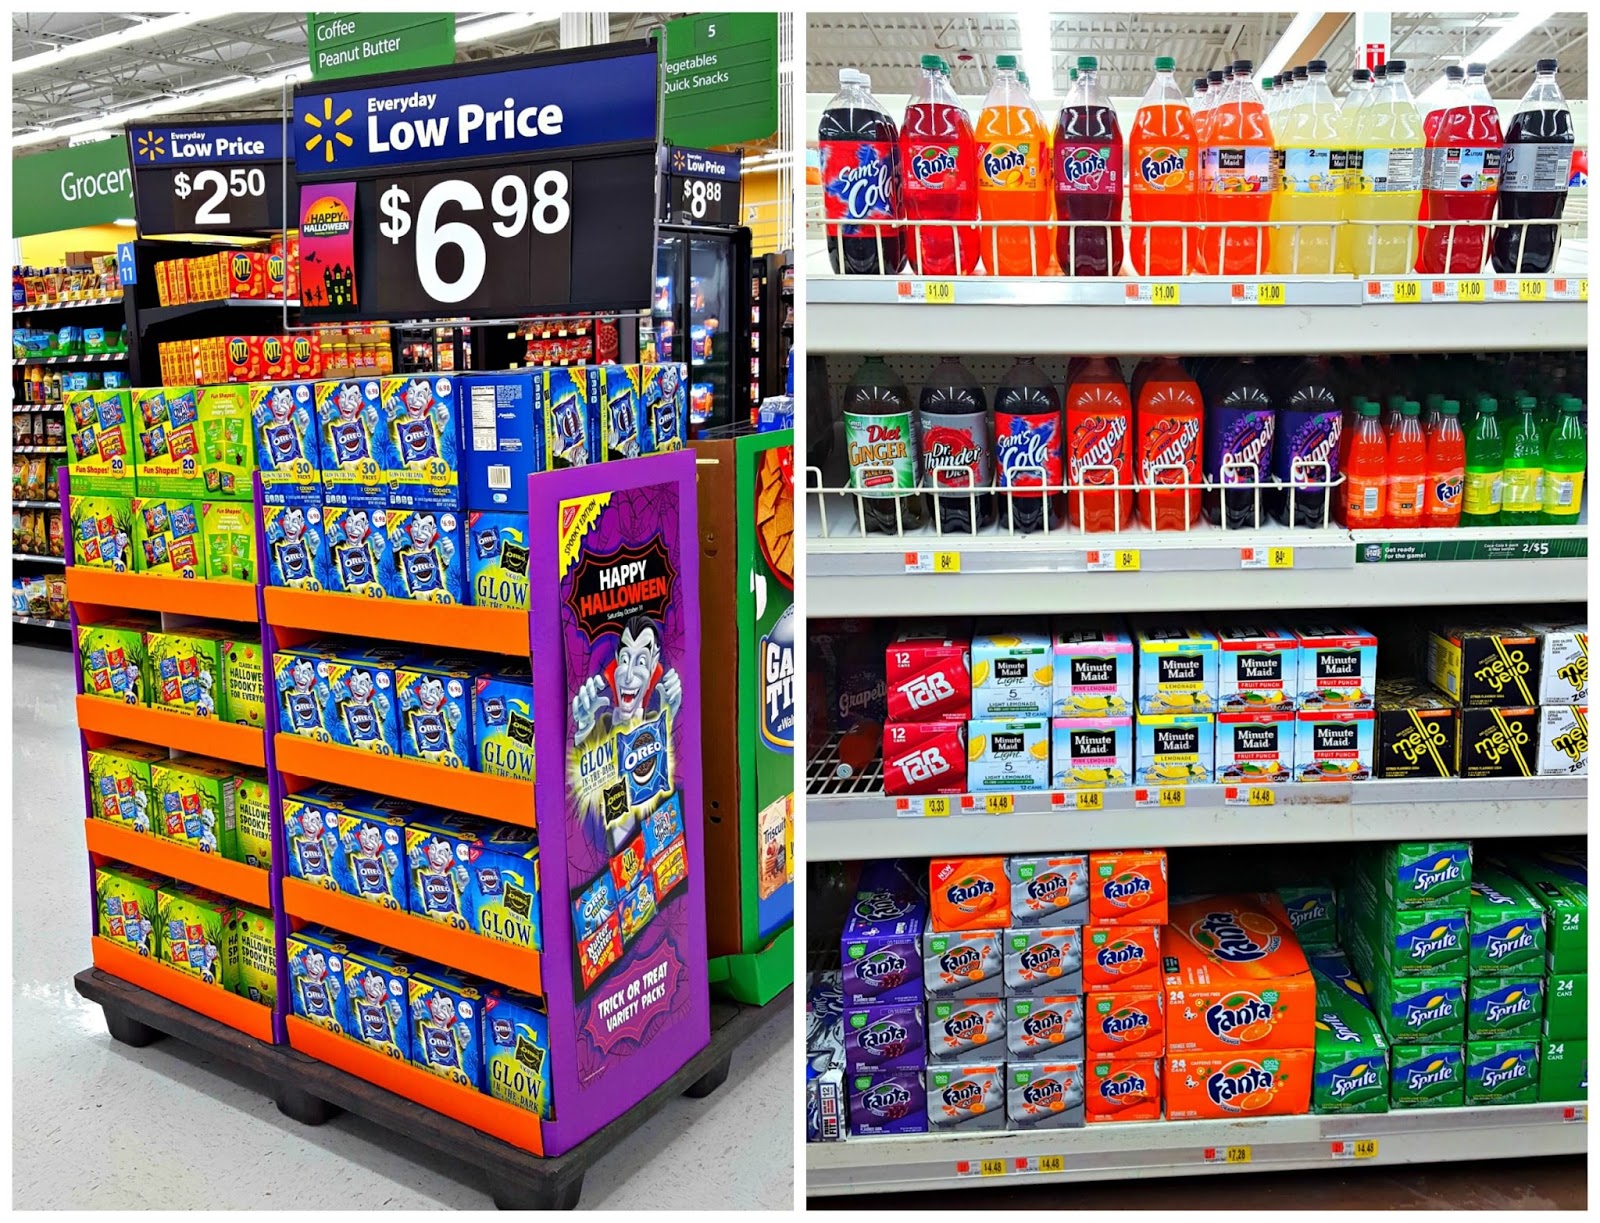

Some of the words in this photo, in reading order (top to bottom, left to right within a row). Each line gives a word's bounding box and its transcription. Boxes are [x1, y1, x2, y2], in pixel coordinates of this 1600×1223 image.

[317, 21, 355, 41] Coffee
[708, 25, 716, 37] 5
[319, 45, 359, 68] Peanut
[363, 37, 400, 58] Butter
[693, 71, 728, 87] Snacks
[368, 93, 437, 113] Everyday
[368, 115, 449, 153] Low
[459, 98, 563, 144] Price
[171, 131, 205, 141] Everyday
[171, 140, 211, 158] Low
[216, 138, 265, 156] Price
[687, 159, 704, 171] Low
[706, 161, 725, 175] Price
[913, 155, 954, 181] Fanta
[1065, 156, 1105, 180] Fanta
[1142, 156, 1183, 181] Fanta
[61, 167, 132, 202] Grocery
[839, 160, 879, 193] Sam's
[850, 168, 894, 218] Cola
[311, 212, 343, 224] HAPPY
[304, 221, 349, 233] HALLOWEEN
[121, 245, 132, 262] A
[121, 267, 133, 282] 11
[232, 259, 250, 278] RITZ
[929, 284, 949, 298] $1.00
[1260, 285, 1280, 299] $1.00
[1397, 283, 1416, 296] $1.00
[1522, 282, 1541, 294] $1.00
[229, 343, 248, 359] RITZ
[294, 342, 312, 358] RITZ
[274, 434, 294, 446] OREO
[867, 425, 901, 443] Diet
[998, 430, 1030, 454] Sam's
[1084, 435, 1099, 449] ENJOY
[1310, 434, 1325, 448] ENJOY
[849, 441, 907, 466] GINGER
[933, 443, 951, 456] Dr.
[1071, 415, 1127, 484] Orangette
[1142, 417, 1199, 485] Orangette
[1223, 414, 1275, 483] Grapett
[1293, 414, 1342, 488] Grapett
[112, 460, 123, 469] 20
[924, 446, 982, 473] Thunder
[1003, 436, 1049, 481] Cola
[88, 467, 109, 475] Shapes!
[156, 467, 179, 476] Shapes!
[297, 462, 310, 473] 30
[565, 524, 580, 555] SPOOKY
[579, 500, 596, 526] EDITION
[1399, 546, 1415, 555] ready
[1523, 542, 1548, 555] 2/$5
[345, 557, 367, 567] OREO
[1408, 553, 1426, 561] game!
[600, 560, 647, 590] HAPPY
[368, 587, 382, 598] 30
[477, 575, 529, 606] GLOW
[581, 576, 666, 617] HALLOWEEN
[607, 609, 624, 621] Saturday,
[624, 607, 638, 616] October
[895, 652, 910, 664] 12
[997, 662, 1025, 670] Minute
[1163, 660, 1199, 670] Minute
[1241, 659, 1277, 668] Minute
[230, 667, 264, 683] HALLOWE
[1075, 663, 1112, 672] Minute
[1168, 669, 1196, 678] Maid
[1246, 668, 1274, 677] Maid
[1081, 671, 1109, 681] Maid
[230, 680, 256, 694] SPOOKY
[1009, 689, 1017, 698] 5
[126, 695, 136, 704] 20
[231, 690, 240, 698] FOR
[242, 692, 264, 703] EVERYO
[197, 705, 208, 717] 20
[294, 702, 314, 712] OREO
[891, 728, 905, 738] 12
[580, 738, 615, 777] GLOW
[624, 741, 662, 770] OREO
[989, 797, 1008, 809] $4.48
[1163, 792, 1181, 803] $4.48
[929, 801, 945, 812] $3.33
[763, 818, 787, 843] Triscuit
[937, 864, 952, 881] NEW
[1028, 876, 1068, 899] Fanta
[1104, 877, 1150, 900] Fanta
[482, 909, 531, 946] GLOW
[1563, 914, 1579, 925] 24
[587, 924, 609, 957] Nutter
[592, 929, 613, 965] Butter
[1412, 935, 1456, 958] Sprite
[1489, 935, 1533, 957] Sprite
[241, 949, 267, 966] SPOOKY
[242, 958, 252, 967] FOR
[940, 949, 980, 972] Fanta
[1097, 948, 1144, 969] Fanta
[598, 988, 625, 1019] TRICK
[627, 978, 640, 1001] OR
[643, 962, 668, 988] TREAT
[1557, 980, 1573, 991] 24
[1170, 991, 1185, 1000] 24
[606, 999, 639, 1032] VARIETY
[641, 982, 665, 1012] PACKS
[1486, 999, 1531, 1022] Sprite
[429, 1037, 453, 1048] OREO
[452, 1071, 468, 1086] 30
[492, 1059, 542, 1100] GLOW
[1207, 1068, 1273, 1103] Fanta
[1331, 1072, 1377, 1096] Sprite
[1229, 1149, 1245, 1161] $7.28
[1357, 1143, 1374, 1154] $4.48
[984, 1161, 1002, 1173] $4.48
